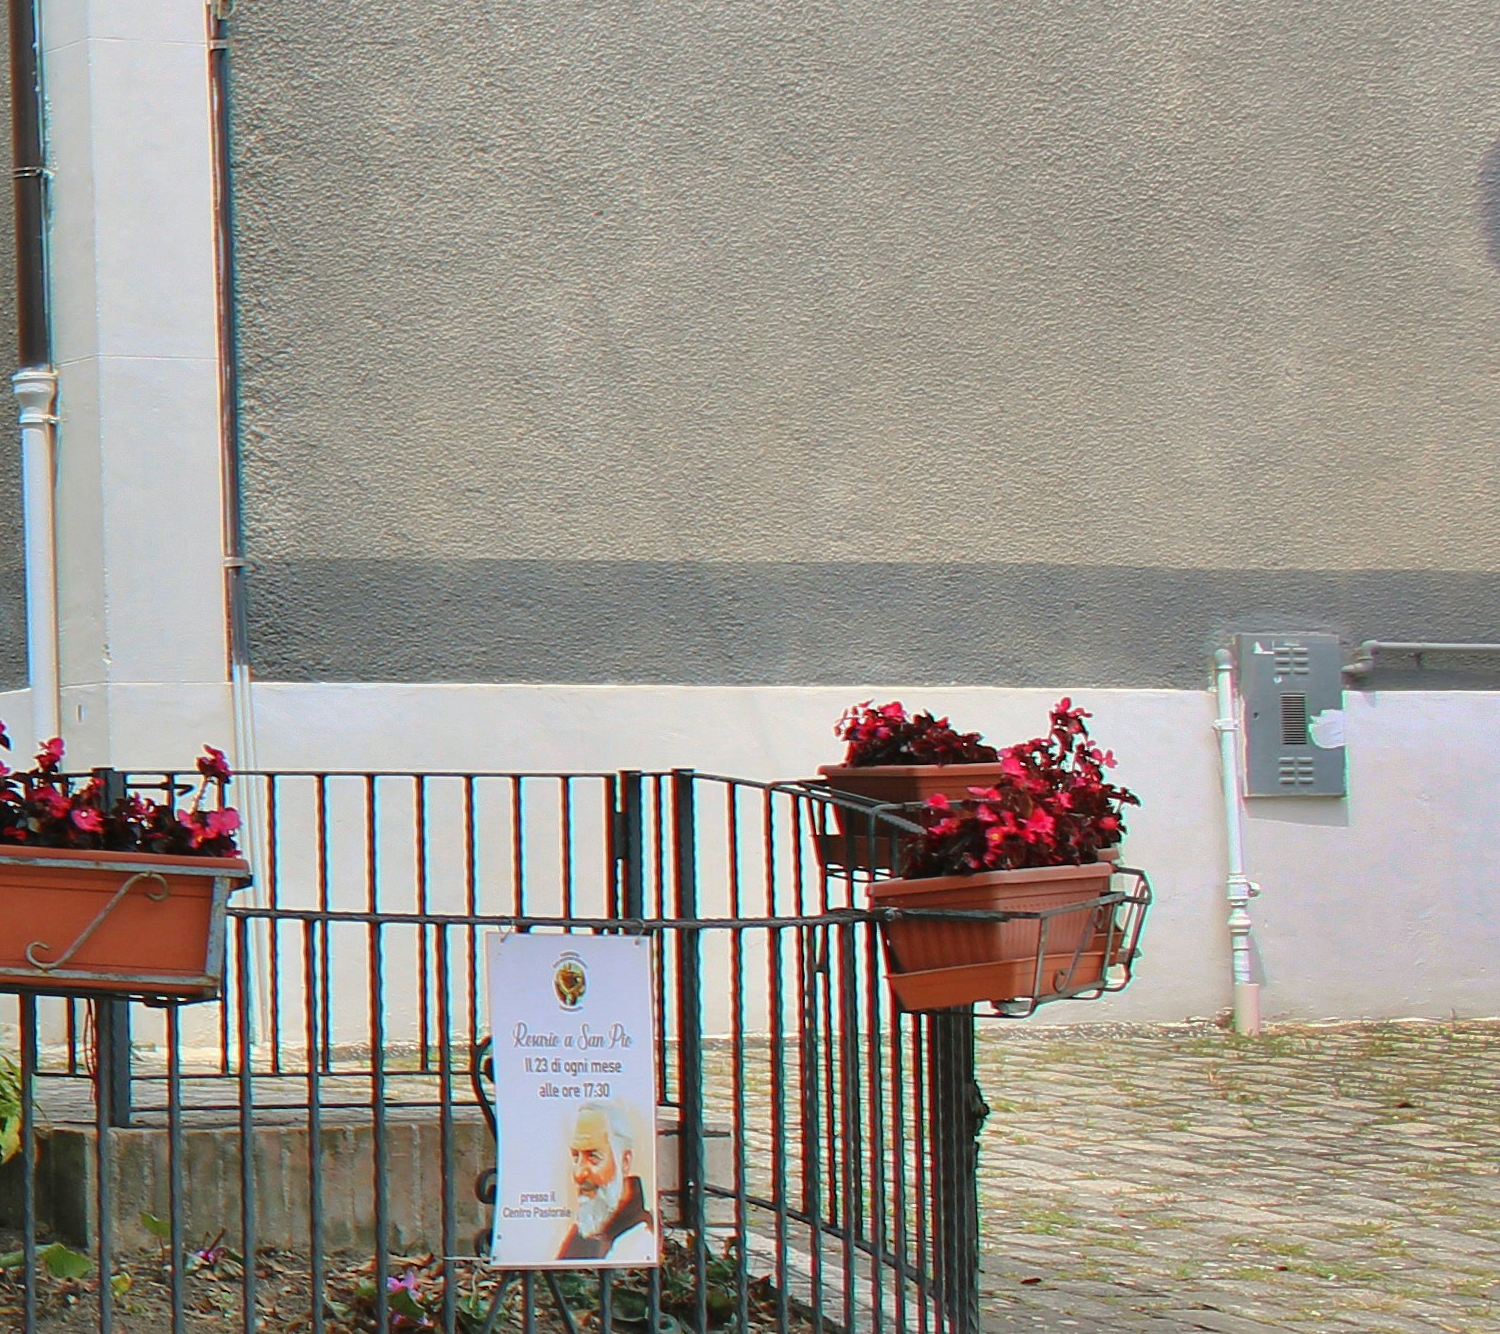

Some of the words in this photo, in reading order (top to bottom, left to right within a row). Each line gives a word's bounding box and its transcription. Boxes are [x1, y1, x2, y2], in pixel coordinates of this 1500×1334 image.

[513, 1022, 558, 1048] Rosario
[564, 1035, 573, 1048] a
[578, 1024, 604, 1050] San
[609, 1023, 632, 1048] Pio
[525, 1058, 533, 1072] Il
[536, 1058, 548, 1072] 23
[551, 1058, 560, 1072] di
[564, 1057, 588, 1076] ogni
[591, 1062, 622, 1073] mese
[539, 1083, 560, 1098] alle
[562, 1086, 580, 1098] ore
[583, 1083, 609, 1098] 17:30
[521, 1194, 548, 1204] presso
[550, 1191, 556, 1202] il
[503, 1207, 531, 1217] Centro
[534, 1207, 571, 1217] Pastorale
